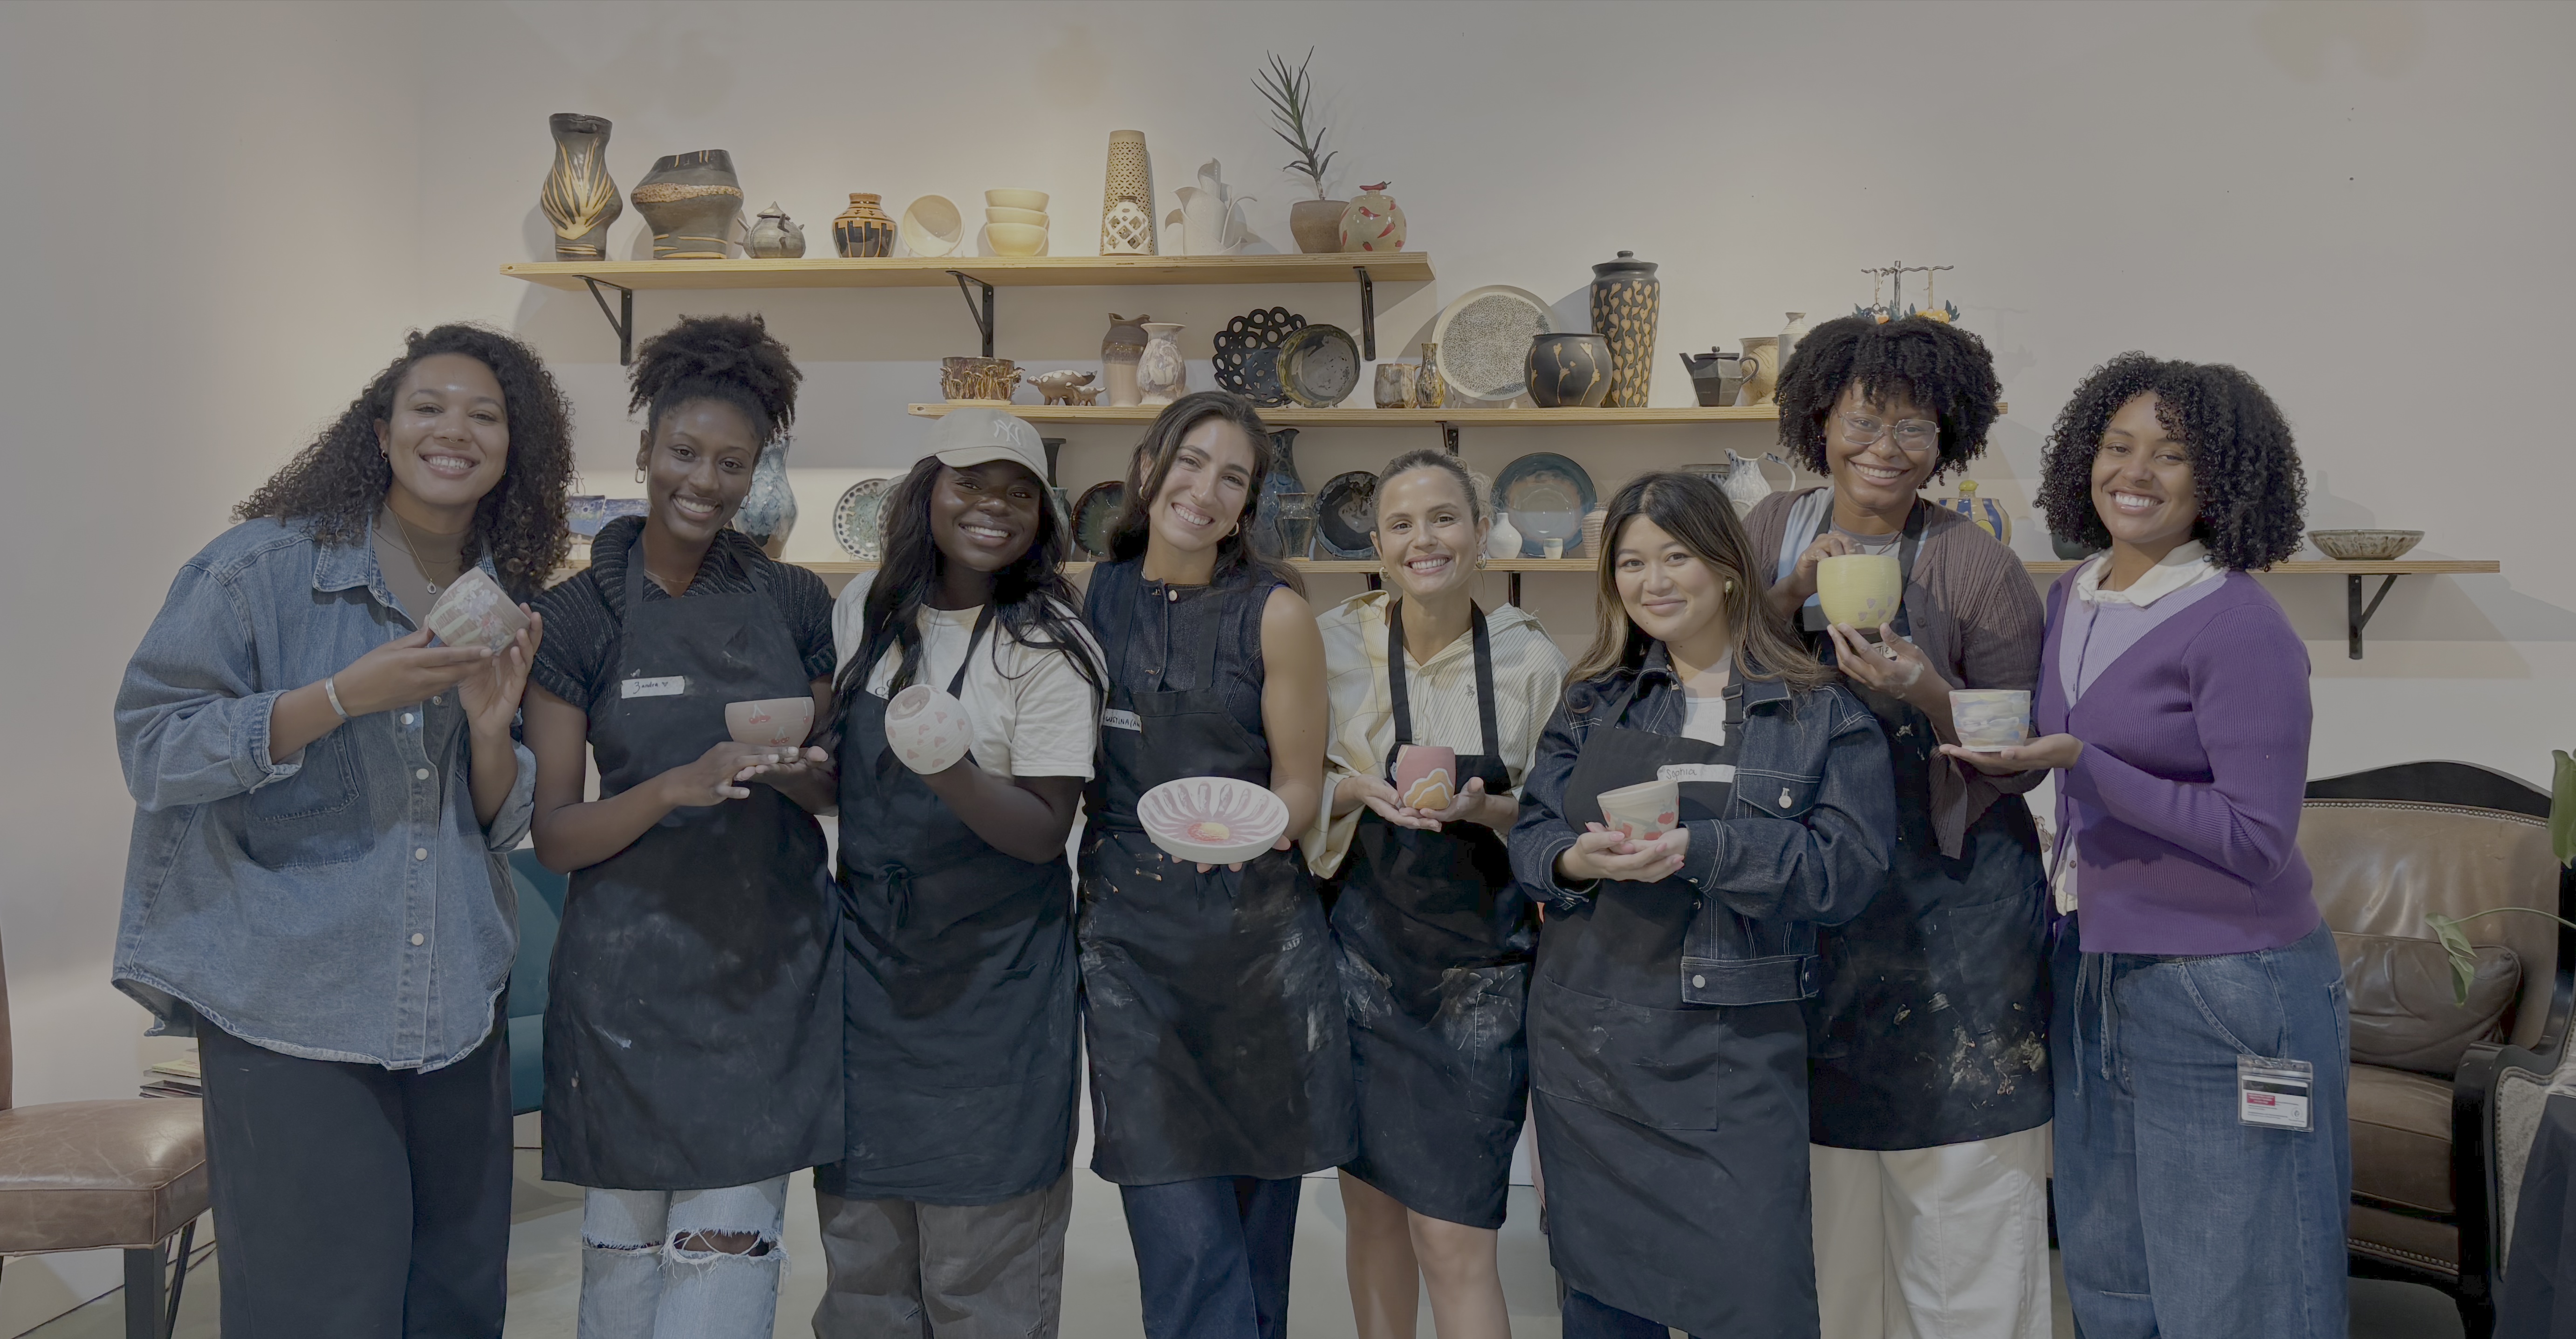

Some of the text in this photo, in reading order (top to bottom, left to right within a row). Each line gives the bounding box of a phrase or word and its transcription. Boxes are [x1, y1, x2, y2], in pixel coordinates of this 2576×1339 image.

[993, 419, 1021, 446] NY
[1104, 716, 1129, 726] GUSTINA
[1666, 768, 1697, 781] Sophia
